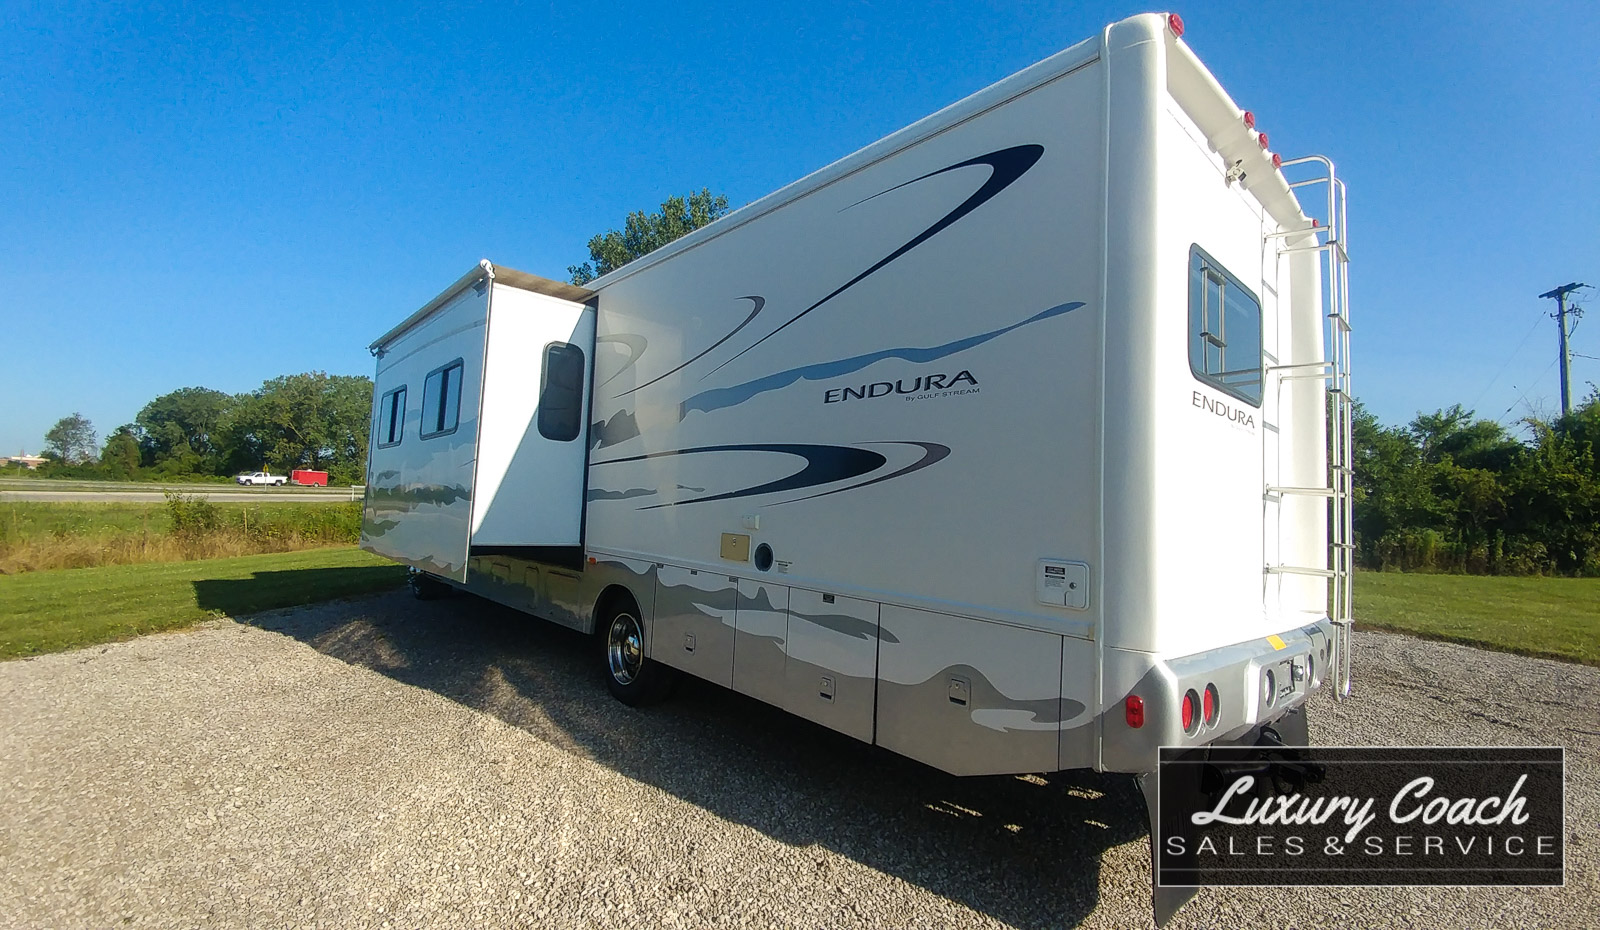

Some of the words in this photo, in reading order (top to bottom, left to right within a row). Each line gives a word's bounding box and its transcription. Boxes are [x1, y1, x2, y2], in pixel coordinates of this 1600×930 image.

[824, 370, 978, 403] ENDURA
[917, 392, 940, 400] GULF
[942, 388, 980, 397] STREAM
[1192, 390, 1255, 429] ENDURA
